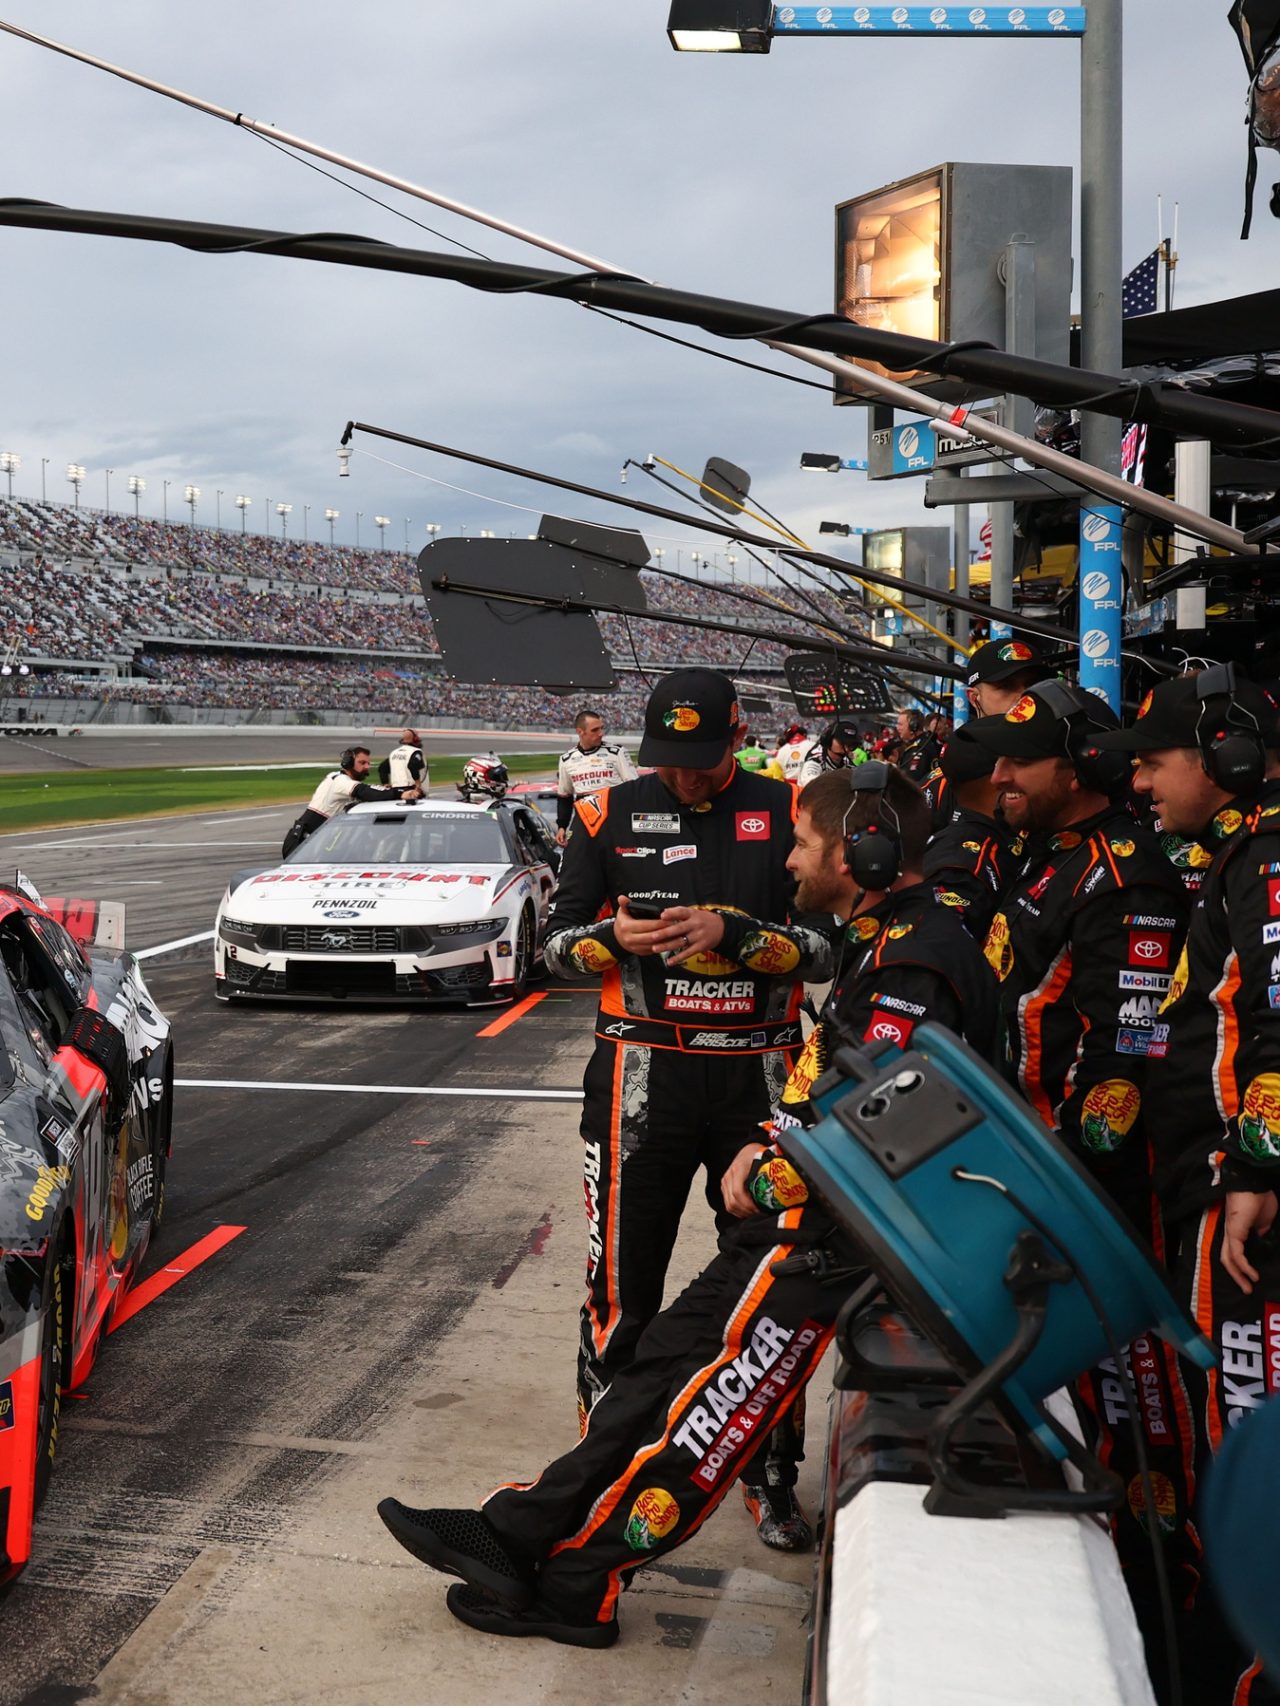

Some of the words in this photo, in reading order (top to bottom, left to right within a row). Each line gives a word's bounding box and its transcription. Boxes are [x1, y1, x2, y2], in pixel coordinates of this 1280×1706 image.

[908, 456, 929, 468] FPL
[1094, 542, 1120, 551] FPL
[1094, 600, 1120, 609] FPL
[1094, 658, 1119, 667] FPL
[571, 770, 613, 782] DISCOUNT
[421, 812, 480, 820] CINDRIC
[665, 847, 695, 860] Lance
[250, 872, 491, 887] DISCOUNT
[321, 881, 393, 889] TIRE
[628, 890, 679, 900] GOODYEAR
[312, 900, 378, 909] PENNZOIL
[1137, 915, 1176, 928] NASCAR
[768, 933, 792, 955] Bass
[230, 946, 237, 959] 2
[1123, 975, 1157, 987] Mobil
[664, 978, 754, 998] TRACKER
[668, 998, 711, 1010] BOATS
[714, 1003, 720, 1011] &
[722, 1000, 750, 1011] ATVs
[882, 995, 926, 1017] NASCAR
[689, 1037, 750, 1048] BRISCOE
[1085, 1084, 1111, 1112] Bass
[1244, 1080, 1263, 1115] Bass
[1101, 1095, 1119, 1118] Pro
[1113, 1086, 1141, 1124] Shops
[130, 1174, 154, 1211] COFFEE
[1140, 1359, 1155, 1368] &
[672, 1316, 793, 1460] TRACKER
[699, 1426, 745, 1482] BOATS
[739, 1416, 754, 1430] &
[751, 1382, 778, 1417] OFF
[773, 1328, 818, 1387] ROAD
[1141, 1372, 1167, 1434] BOATS
[635, 1489, 656, 1515] Bass
[643, 1503, 662, 1523] Pro
[652, 1502, 681, 1530] Shops
